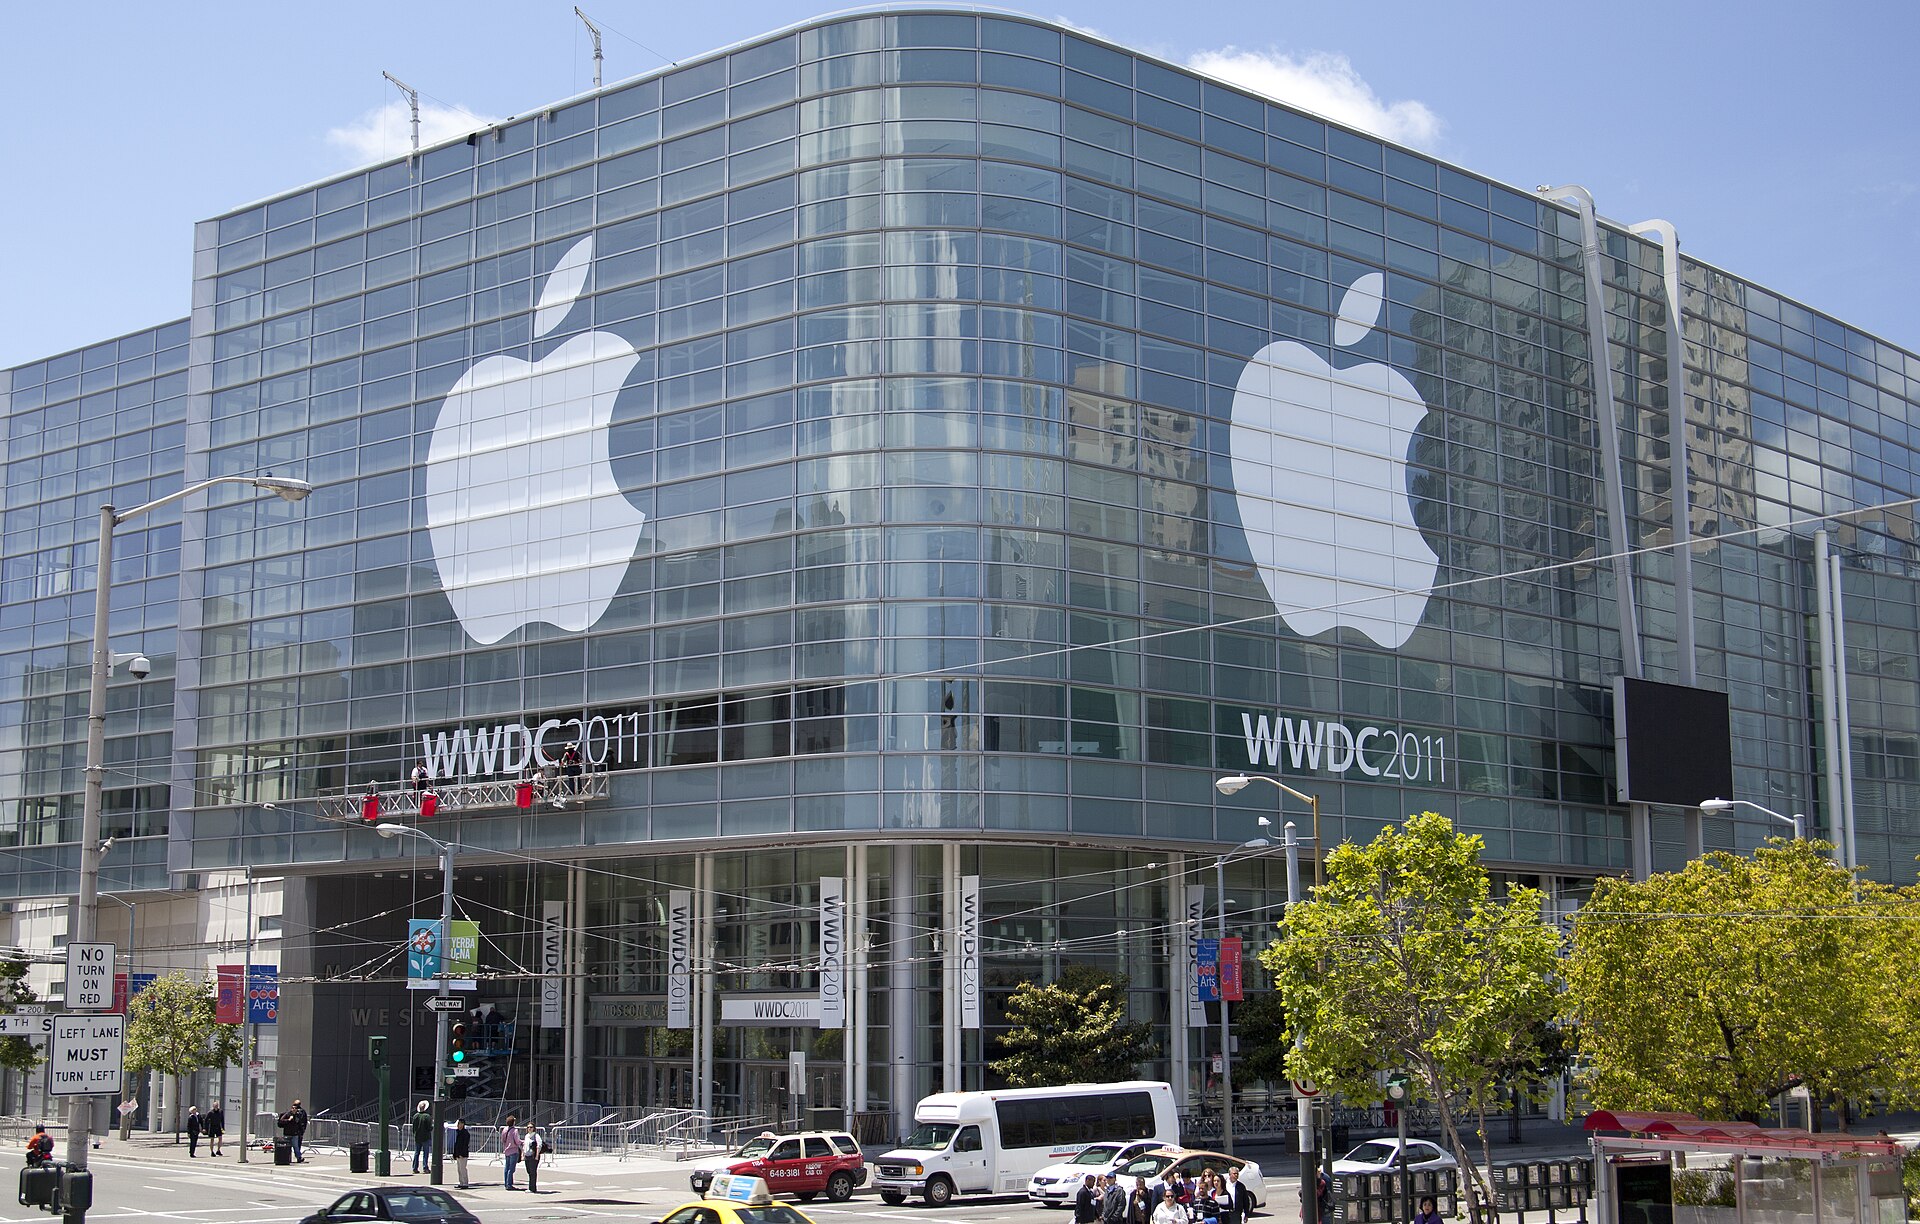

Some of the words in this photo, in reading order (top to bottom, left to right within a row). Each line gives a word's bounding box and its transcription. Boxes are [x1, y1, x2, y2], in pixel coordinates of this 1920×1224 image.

[422, 711, 638, 780] WWDC2011
[1241, 713, 1445, 783] WWDC2011
[451, 937, 475, 949] YERBA
[81, 949, 104, 962] NO
[823, 894, 840, 1012] WWDC2011
[963, 891, 978, 1012] WWDC2011
[544, 915, 560, 1014] WWDC2011
[670, 905, 688, 1013] WWDC2011
[77, 965, 105, 976] TURN
[82, 979, 99, 990] ON
[1200, 975, 1216, 987] Arts
[79, 993, 100, 1004] RED
[252, 999, 276, 1010] Arts
[27, 1006, 42, 1014] 200
[603, 1004, 649, 1017] MOSCONE
[754, 1001, 809, 1018] WWDC2011
[351, 1008, 428, 1026] WEST
[42, 1019, 52, 1031] S
[60, 1028, 86, 1039] LEFT
[92, 1027, 120, 1038] LANE
[67, 1049, 108, 1062] MUST
[56, 1071, 84, 1082] TURN
[90, 1070, 115, 1081] LEFT
[769, 1169, 800, 1178] 648-3181
